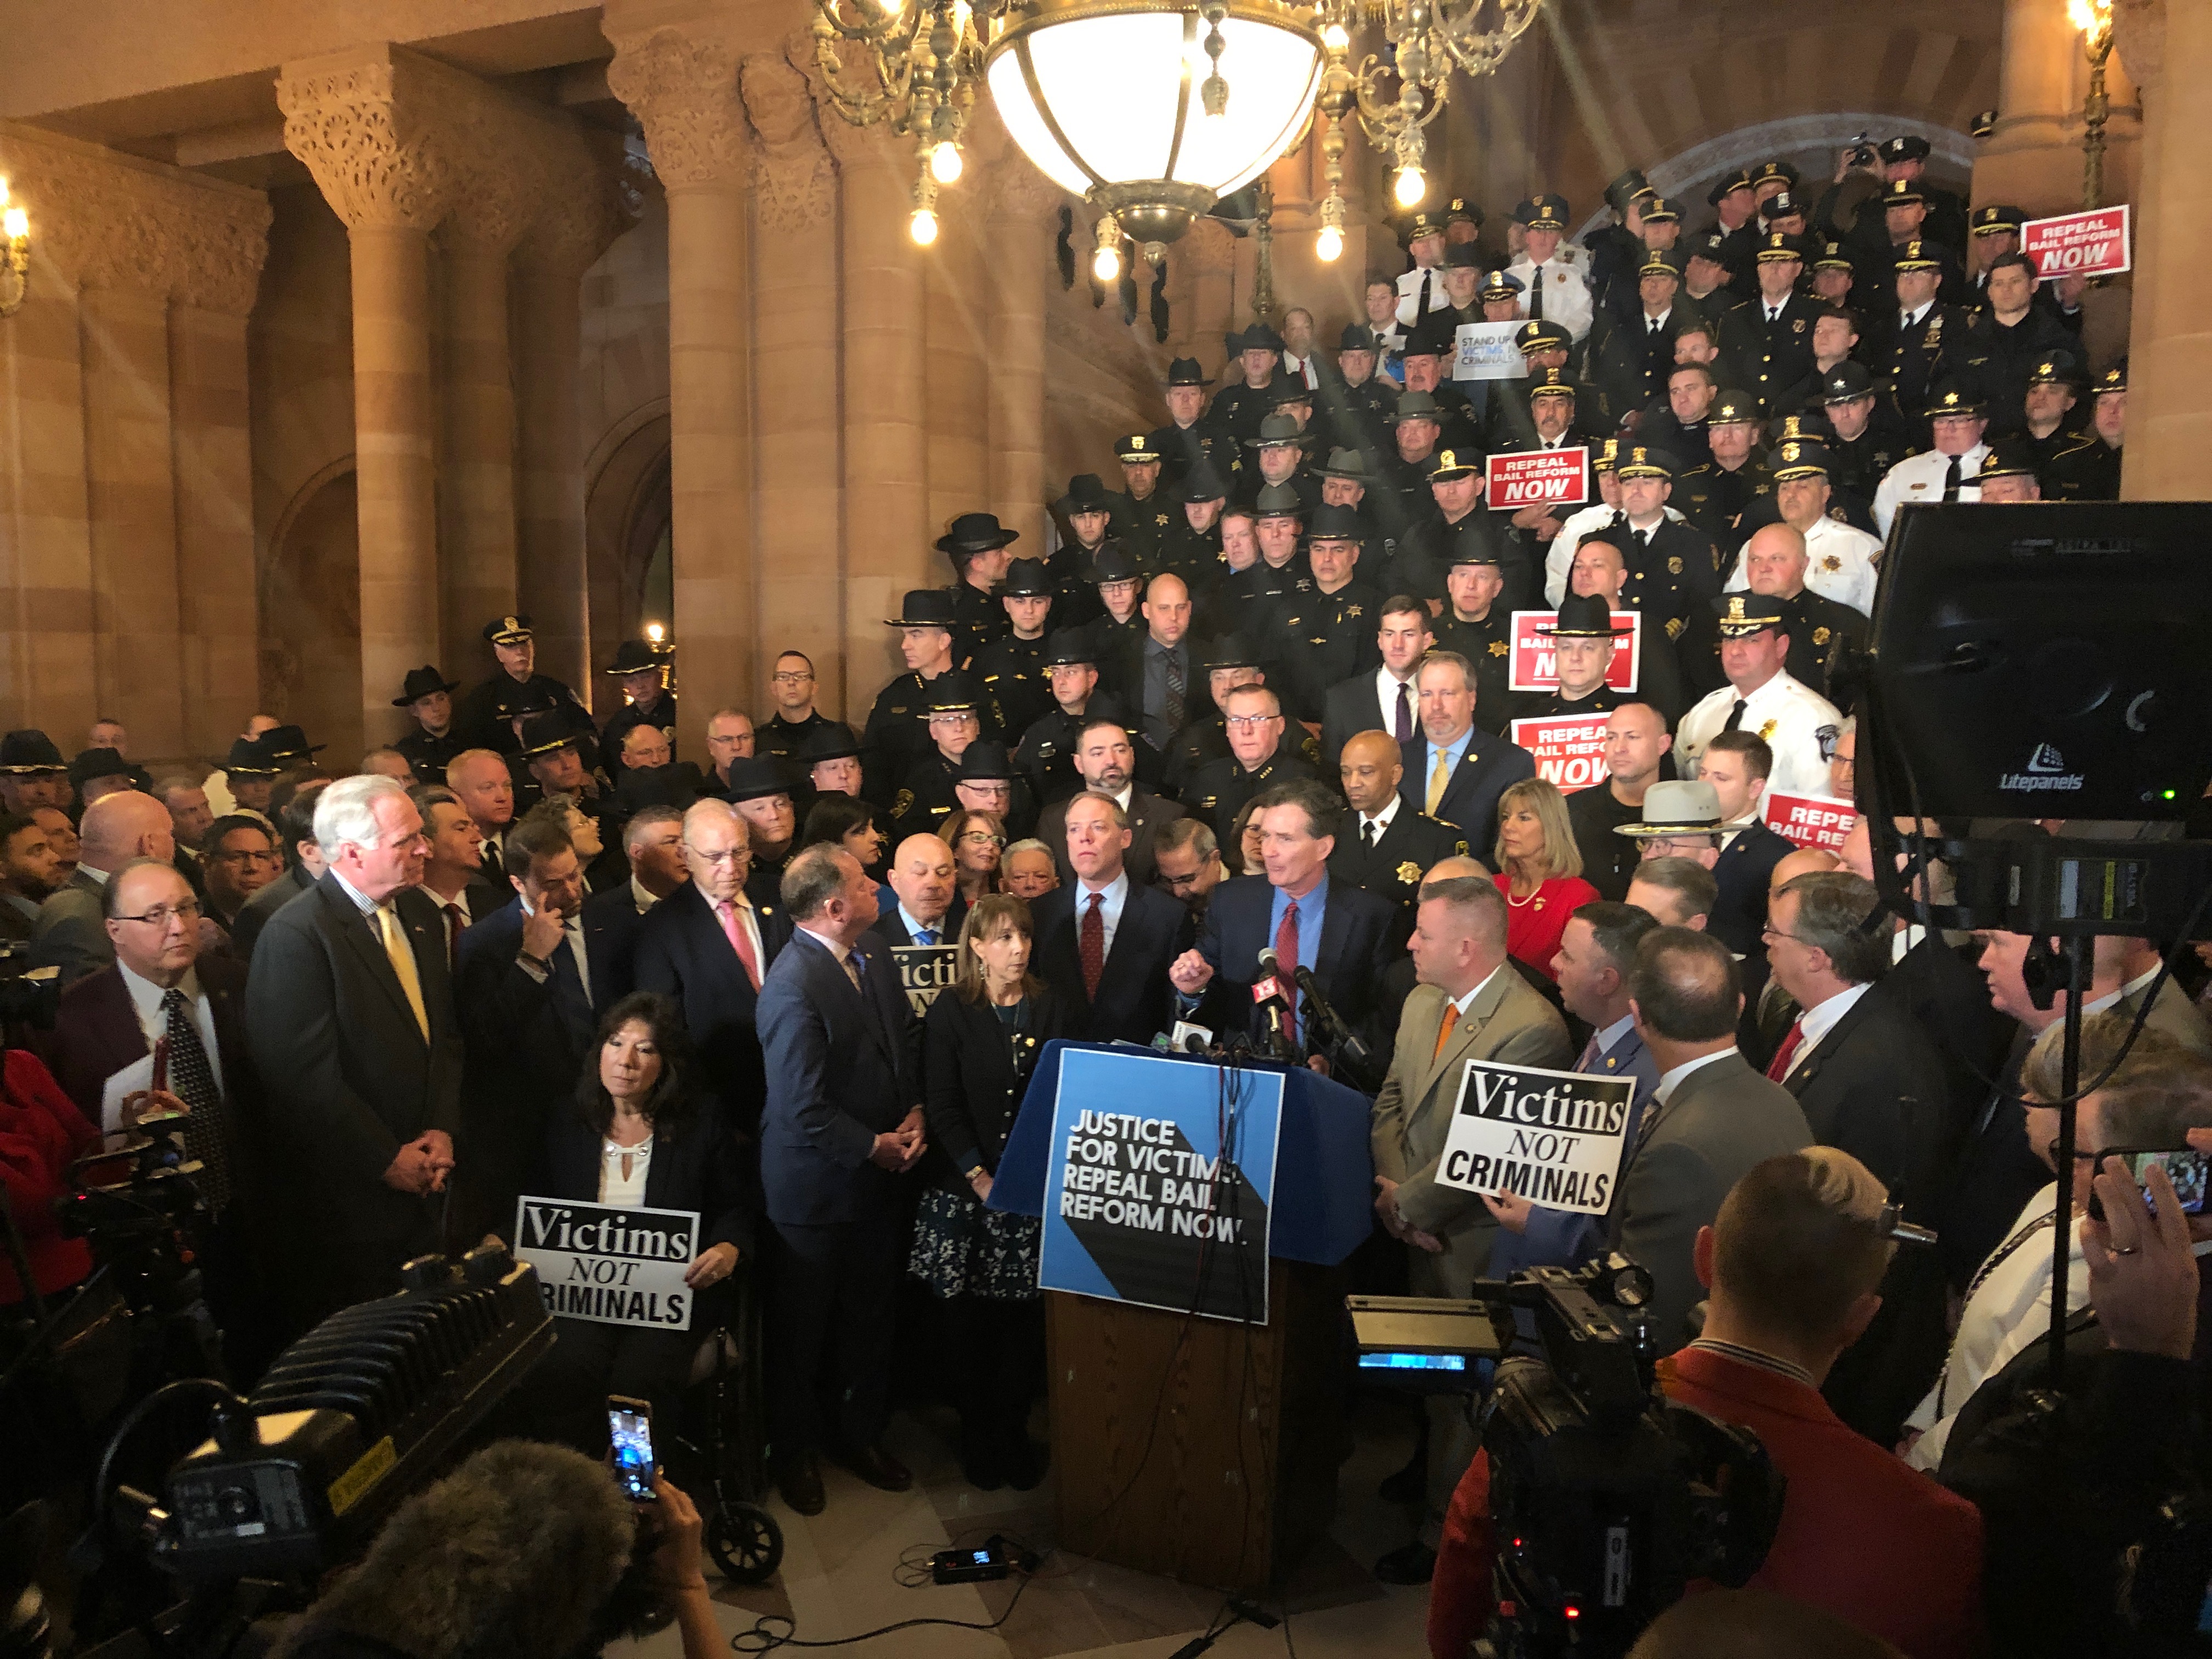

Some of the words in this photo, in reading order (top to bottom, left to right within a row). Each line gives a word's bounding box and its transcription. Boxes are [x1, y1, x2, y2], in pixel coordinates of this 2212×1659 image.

[2029, 240, 2062, 251] BAIL
[2064, 228, 2120, 246] REFORM
[2042, 219, 2108, 239] REPEAL
[2041, 241, 2109, 270] NOW
[1462, 336, 1496, 346] STAND
[1498, 335, 1511, 343] UP
[1494, 472, 1523, 482] BAIL
[1526, 466, 1580, 478] REFORM
[1506, 457, 1568, 471] REPEAL
[1504, 478, 1570, 500] NOW
[1520, 638, 1555, 648] BAIL
[1538, 725, 1606, 743] REPEA
[1999, 774, 2085, 792] Litepanels
[1769, 821, 1813, 840] BAIL
[1790, 806, 1855, 831] REPE
[893, 952, 958, 987] icti
[1256, 979, 1276, 998] 13
[1471, 1070, 1624, 1132] Victims
[1069, 1109, 1175, 1146] JUSTICE
[1065, 1136, 1118, 1166] FOR
[1505, 1129, 1581, 1164] NOT
[1063, 1163, 1153, 1201] REPEAL
[1161, 1178, 1216, 1211] BAIL
[1446, 1150, 1610, 1209] CRIMINALS
[1059, 1191, 1164, 1232] REFORM
[526, 1206, 690, 1260] Victims
[568, 1257, 640, 1286] NOT
[539, 1282, 685, 1324] RIMINALS
